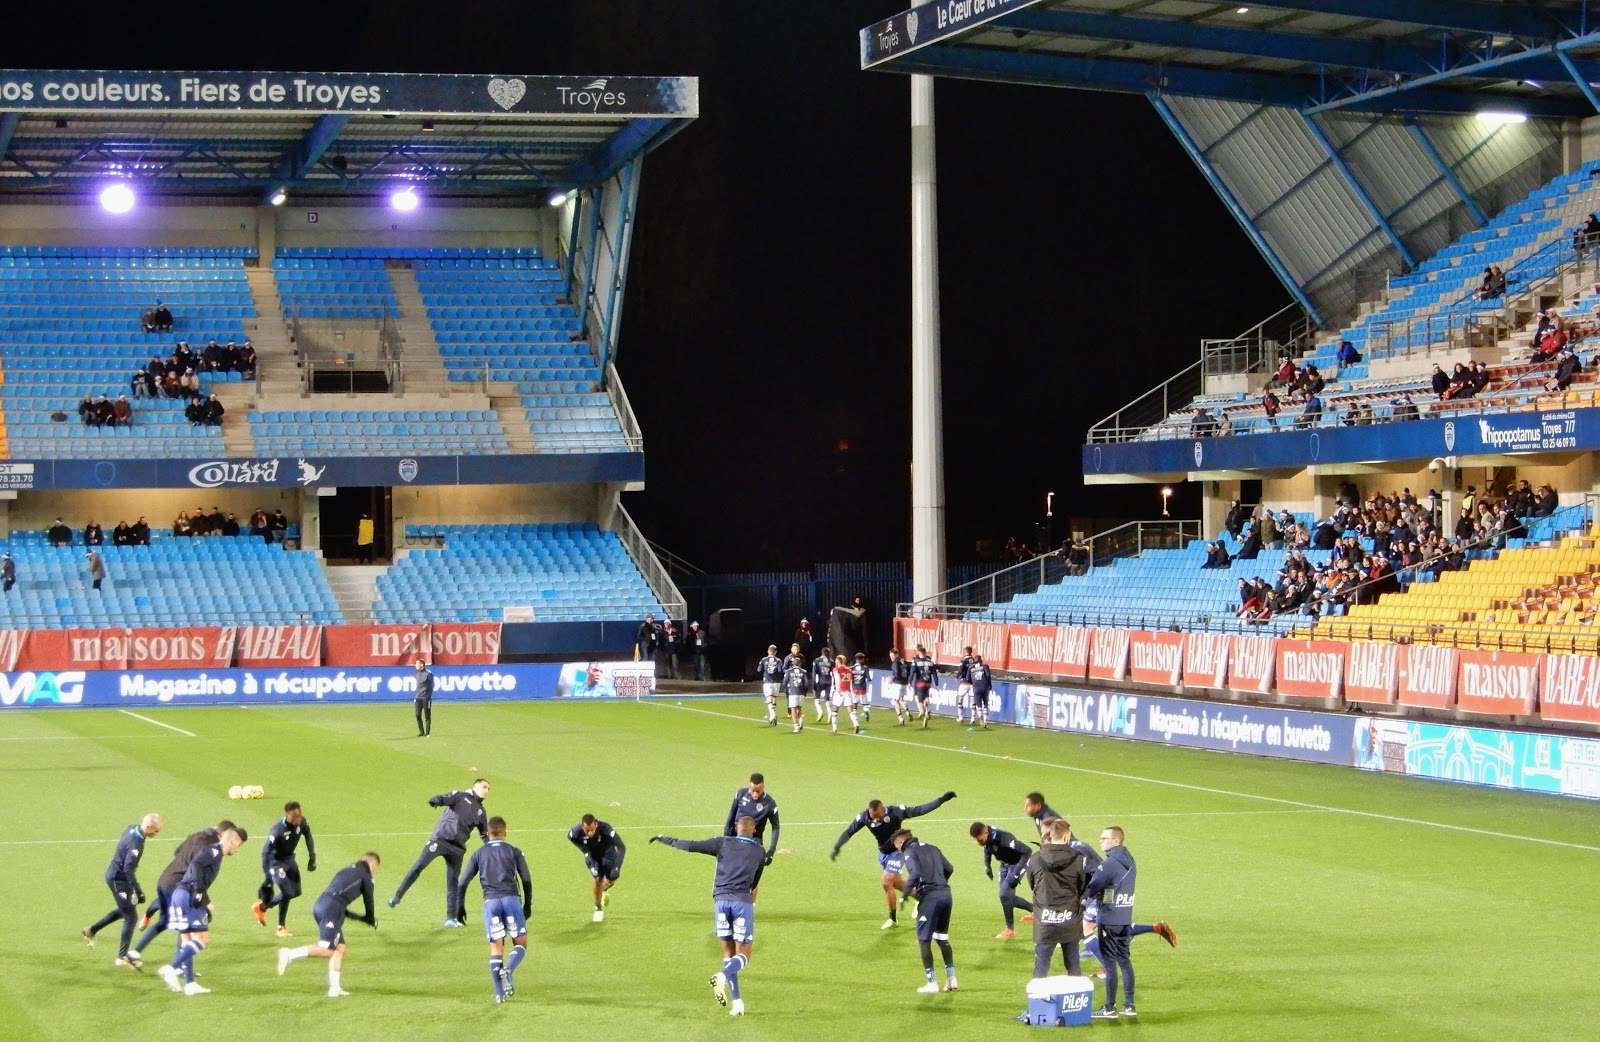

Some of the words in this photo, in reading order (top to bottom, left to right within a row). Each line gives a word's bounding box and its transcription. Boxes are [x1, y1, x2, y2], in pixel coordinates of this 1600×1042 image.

[937, 6, 947, 29] Le
[878, 32, 899, 53] Troyes
[0, 82, 34, 101] os
[43, 77, 171, 102] couleurs.
[181, 79, 241, 101] Fiers
[250, 79, 286, 102] de
[294, 80, 381, 108] Troyes
[556, 86, 626, 111] Troyes
[1541, 421, 1562, 437] Troyes
[1565, 419, 1576, 434] 7/7
[72, 628, 205, 662] maisons
[371, 623, 499, 656] maisons
[119, 672, 237, 702] Magazine
[243, 672, 258, 694] à
[265, 671, 382, 699] récupérer
[1052, 693, 1094, 732] ESTAC
[1097, 693, 1138, 736] MAG
[1149, 704, 1200, 741] Magazine
[1201, 710, 1209, 738] à
[1210, 712, 1264, 749] récupérer
[1266, 722, 1282, 746] en
[1283, 717, 1331, 752] buvette
[1041, 908, 1073, 923] PiLeJe
[1062, 993, 1089, 1012] PiLeJe
